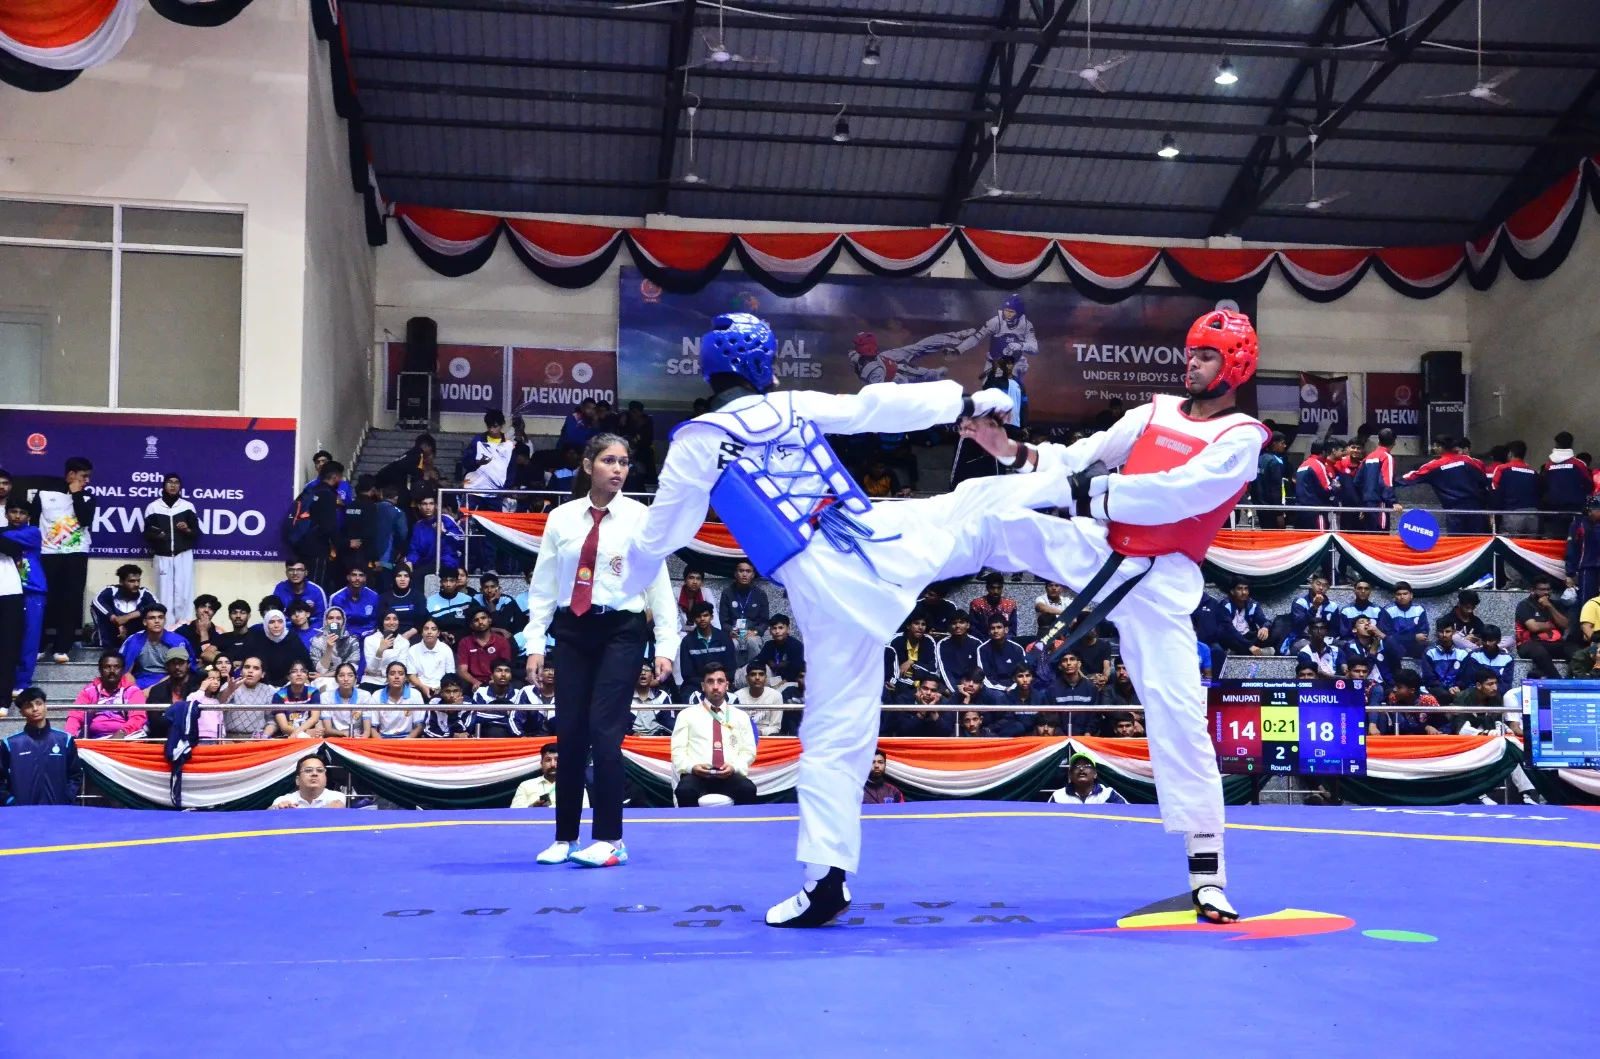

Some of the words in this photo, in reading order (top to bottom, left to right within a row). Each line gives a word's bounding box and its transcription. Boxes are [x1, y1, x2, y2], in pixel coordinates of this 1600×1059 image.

[1072, 344, 1188, 365] TAEKWON
[1083, 370, 1120, 381] UNDER
[1123, 371, 1136, 381] 19
[1137, 371, 1169, 383] (BOYS
[1171, 373, 1179, 383] &
[521, 386, 614, 405] TAEKWONDO
[1085, 390, 1099, 400] 9th
[1126, 391, 1137, 401] to
[1375, 408, 1419, 424] TAEKW
[131, 471, 165, 483] 69th
[192, 488, 244, 500] GAMES
[1403, 522, 1434, 537] PLAYERS
[1222, 694, 1260, 703] MINUPATI
[1299, 694, 1339, 704] NASIRUL
[1229, 720, 1256, 740] 14
[1263, 719, 1296, 733] 0:21
[1306, 721, 1334, 742] 18
[1275, 747, 1285, 760] 2
[1247, 763, 1253, 771] 0
